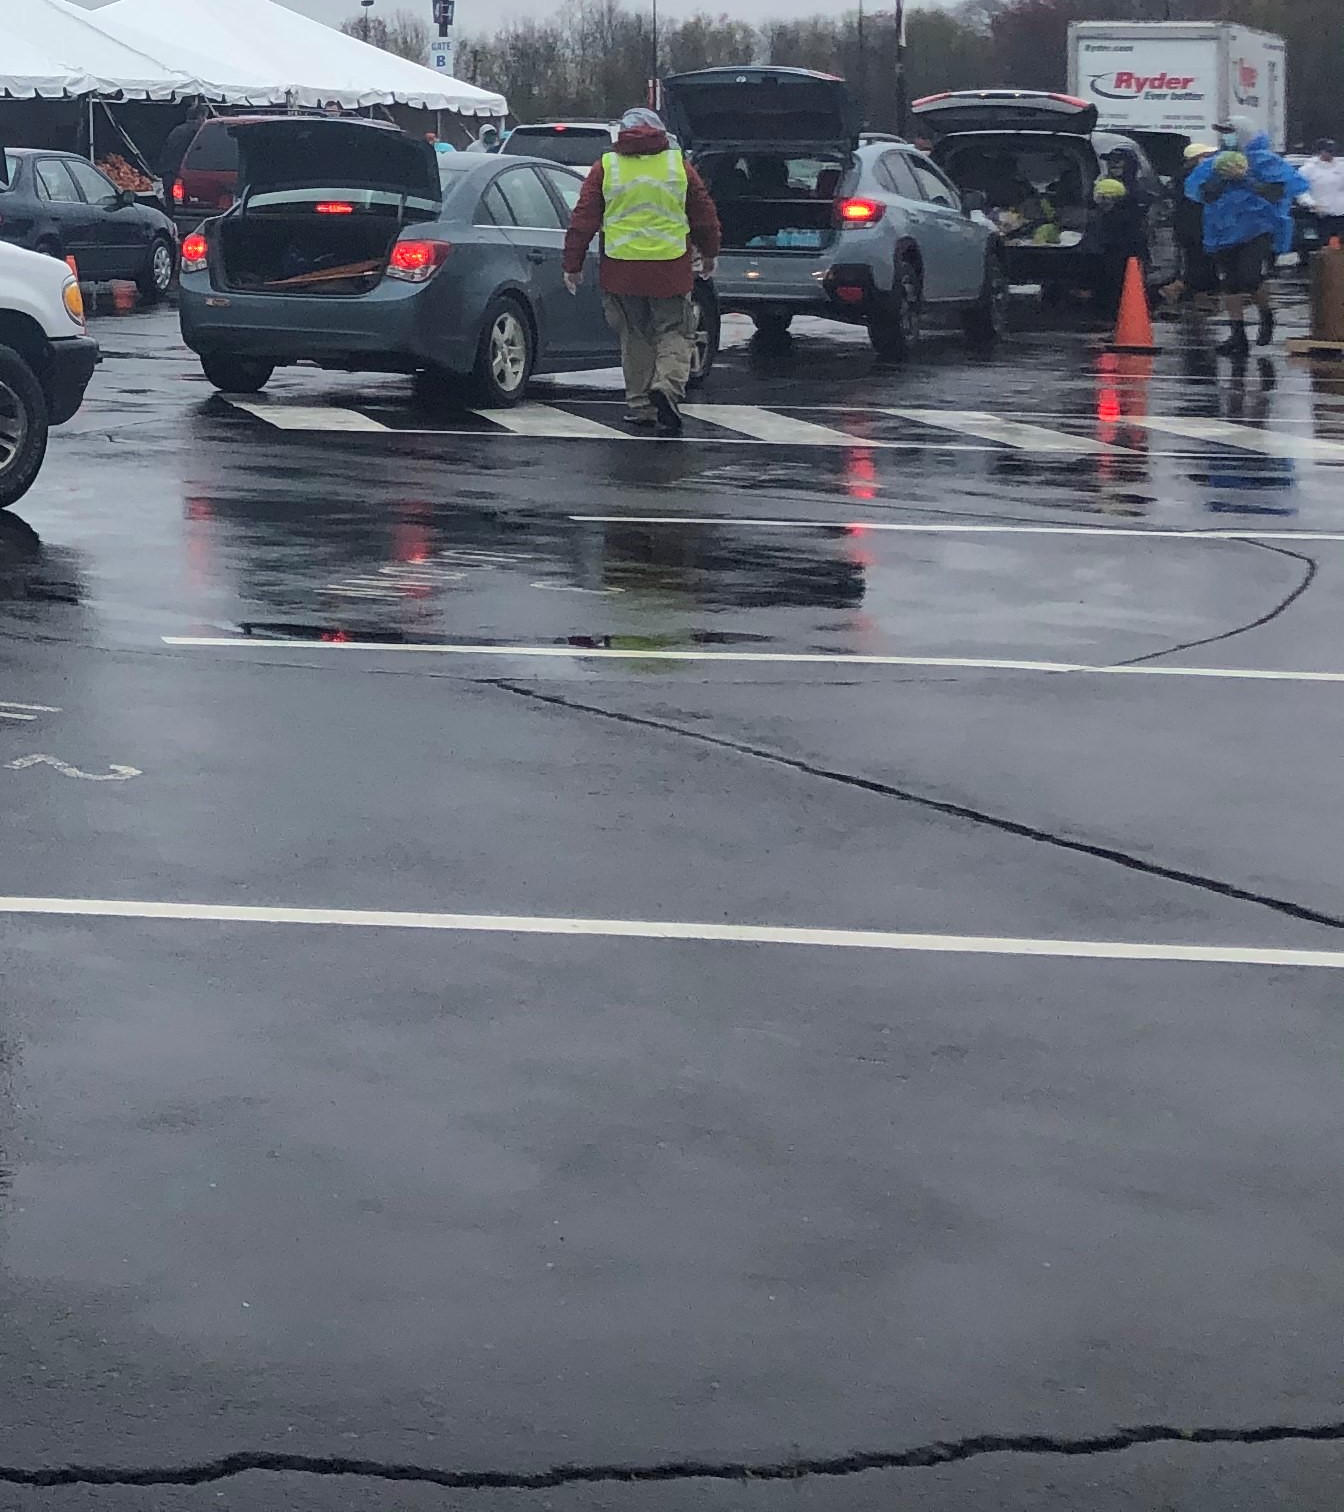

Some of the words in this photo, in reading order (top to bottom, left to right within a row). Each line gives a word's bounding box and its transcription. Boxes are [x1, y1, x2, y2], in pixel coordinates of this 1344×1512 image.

[431, 41, 451, 51] GATE
[436, 55, 446, 68] B
[1114, 72, 1195, 93] Ryder
[1144, 91, 1168, 100] Ever
[1170, 91, 1204, 101] better
